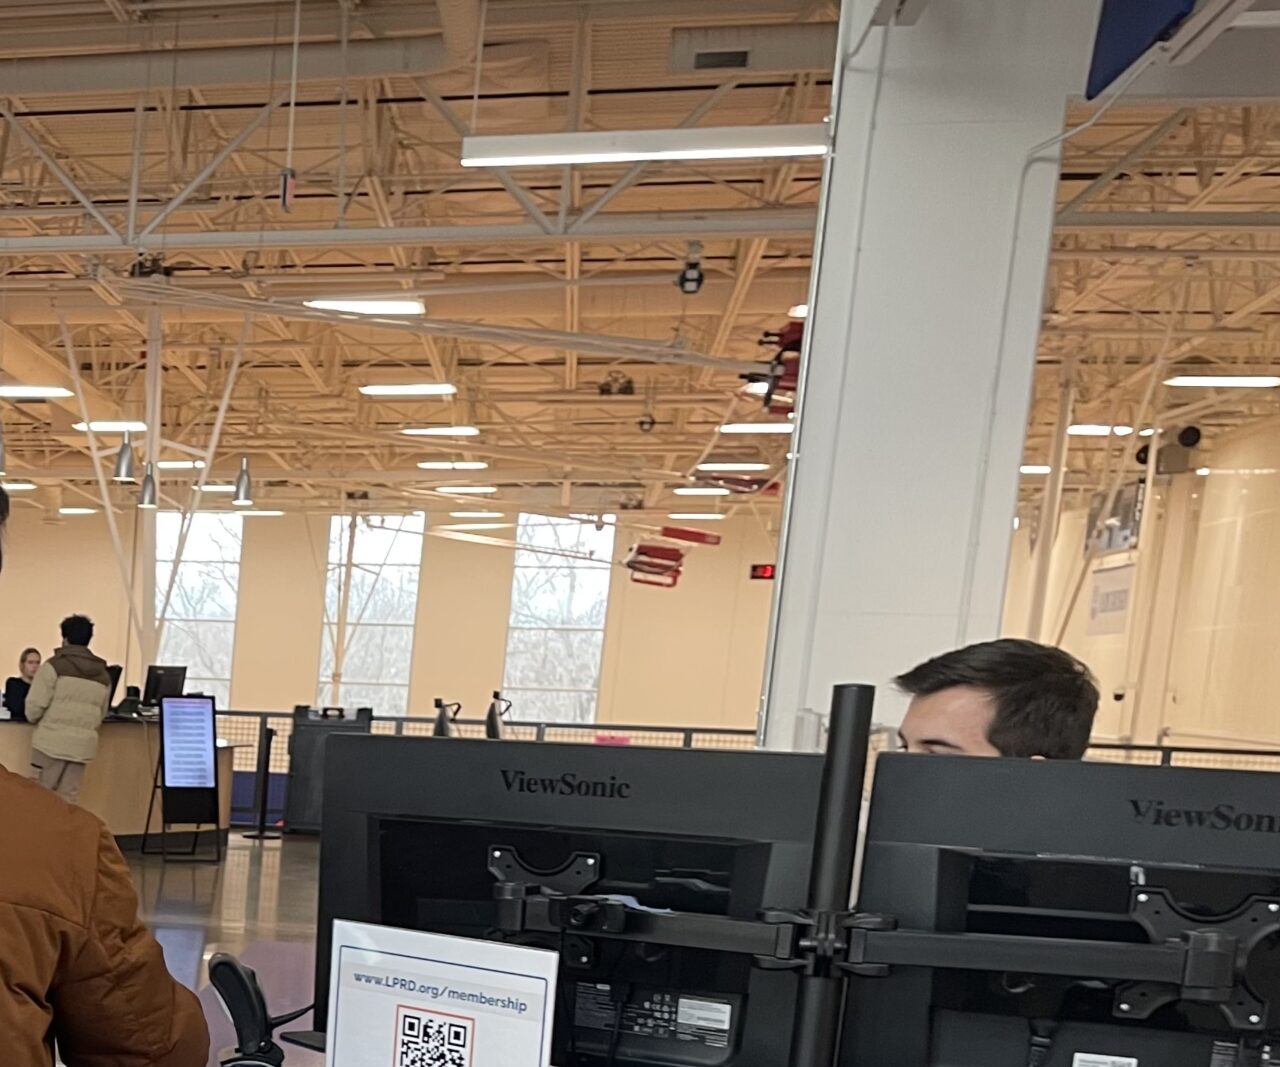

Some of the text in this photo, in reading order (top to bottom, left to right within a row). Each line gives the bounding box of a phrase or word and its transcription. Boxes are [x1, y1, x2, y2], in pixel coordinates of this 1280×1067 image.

[500, 769, 631, 799] ViewSonic
[1129, 799, 1280, 833] ViewSon
[354, 972, 527, 1013] www.LPRD.org/membership
